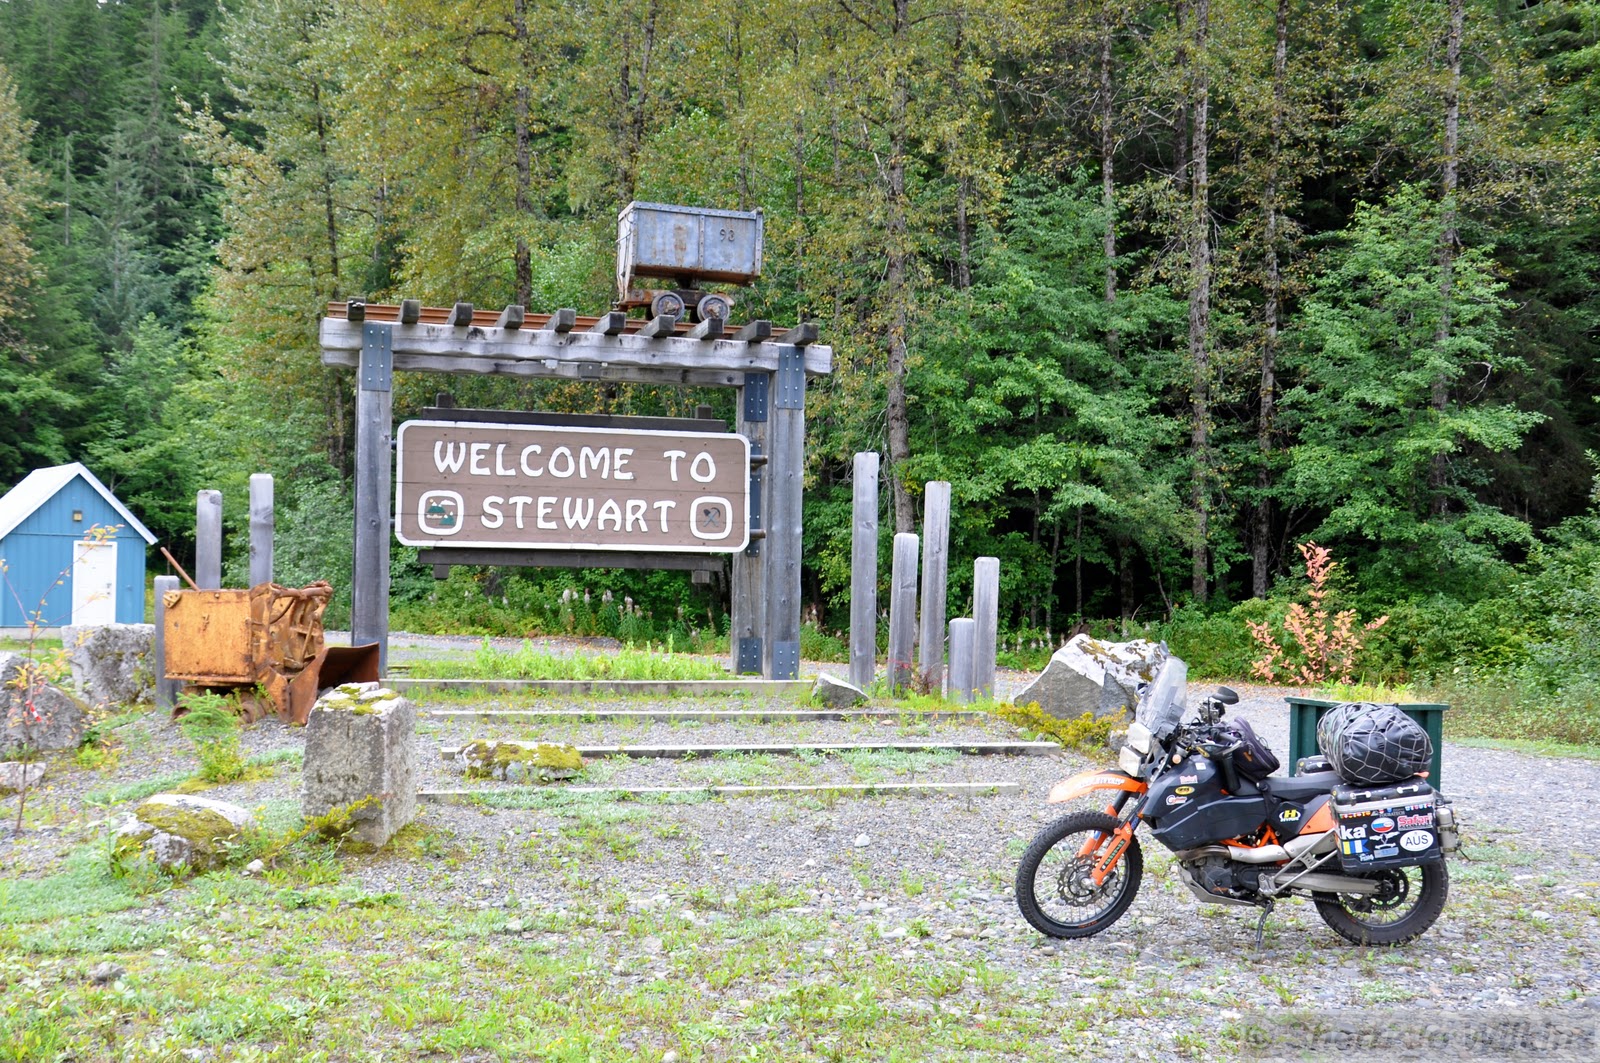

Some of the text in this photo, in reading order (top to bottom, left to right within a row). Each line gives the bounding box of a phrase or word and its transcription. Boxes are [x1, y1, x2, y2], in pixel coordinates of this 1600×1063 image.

[434, 440, 716, 483] WELCOME TO
[480, 495, 677, 533] STEWART
[1405, 835, 1429, 846] AUS
